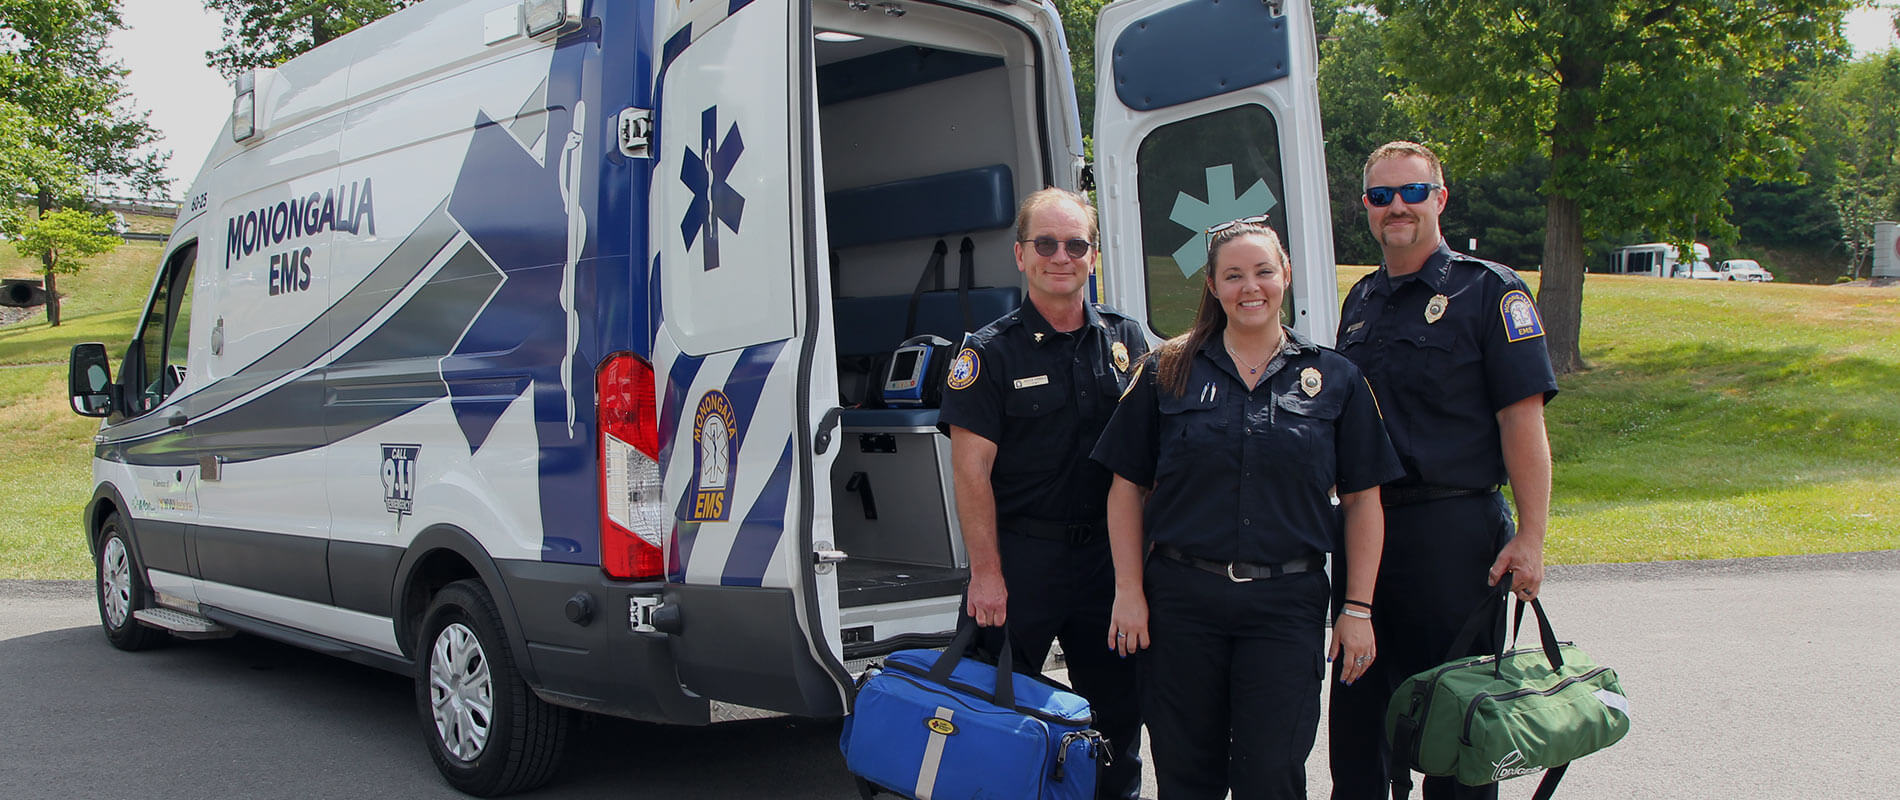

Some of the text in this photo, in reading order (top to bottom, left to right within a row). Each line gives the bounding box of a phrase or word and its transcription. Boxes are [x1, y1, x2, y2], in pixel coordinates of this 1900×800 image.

[190, 192, 208, 211] 60-25
[225, 177, 376, 269] MONONGALIA
[269, 247, 312, 296] EMS
[1518, 326, 1534, 336] EMS
[693, 394, 737, 442] MONONGALIA
[391, 448, 408, 460] CALL
[694, 492, 725, 519] EMS
